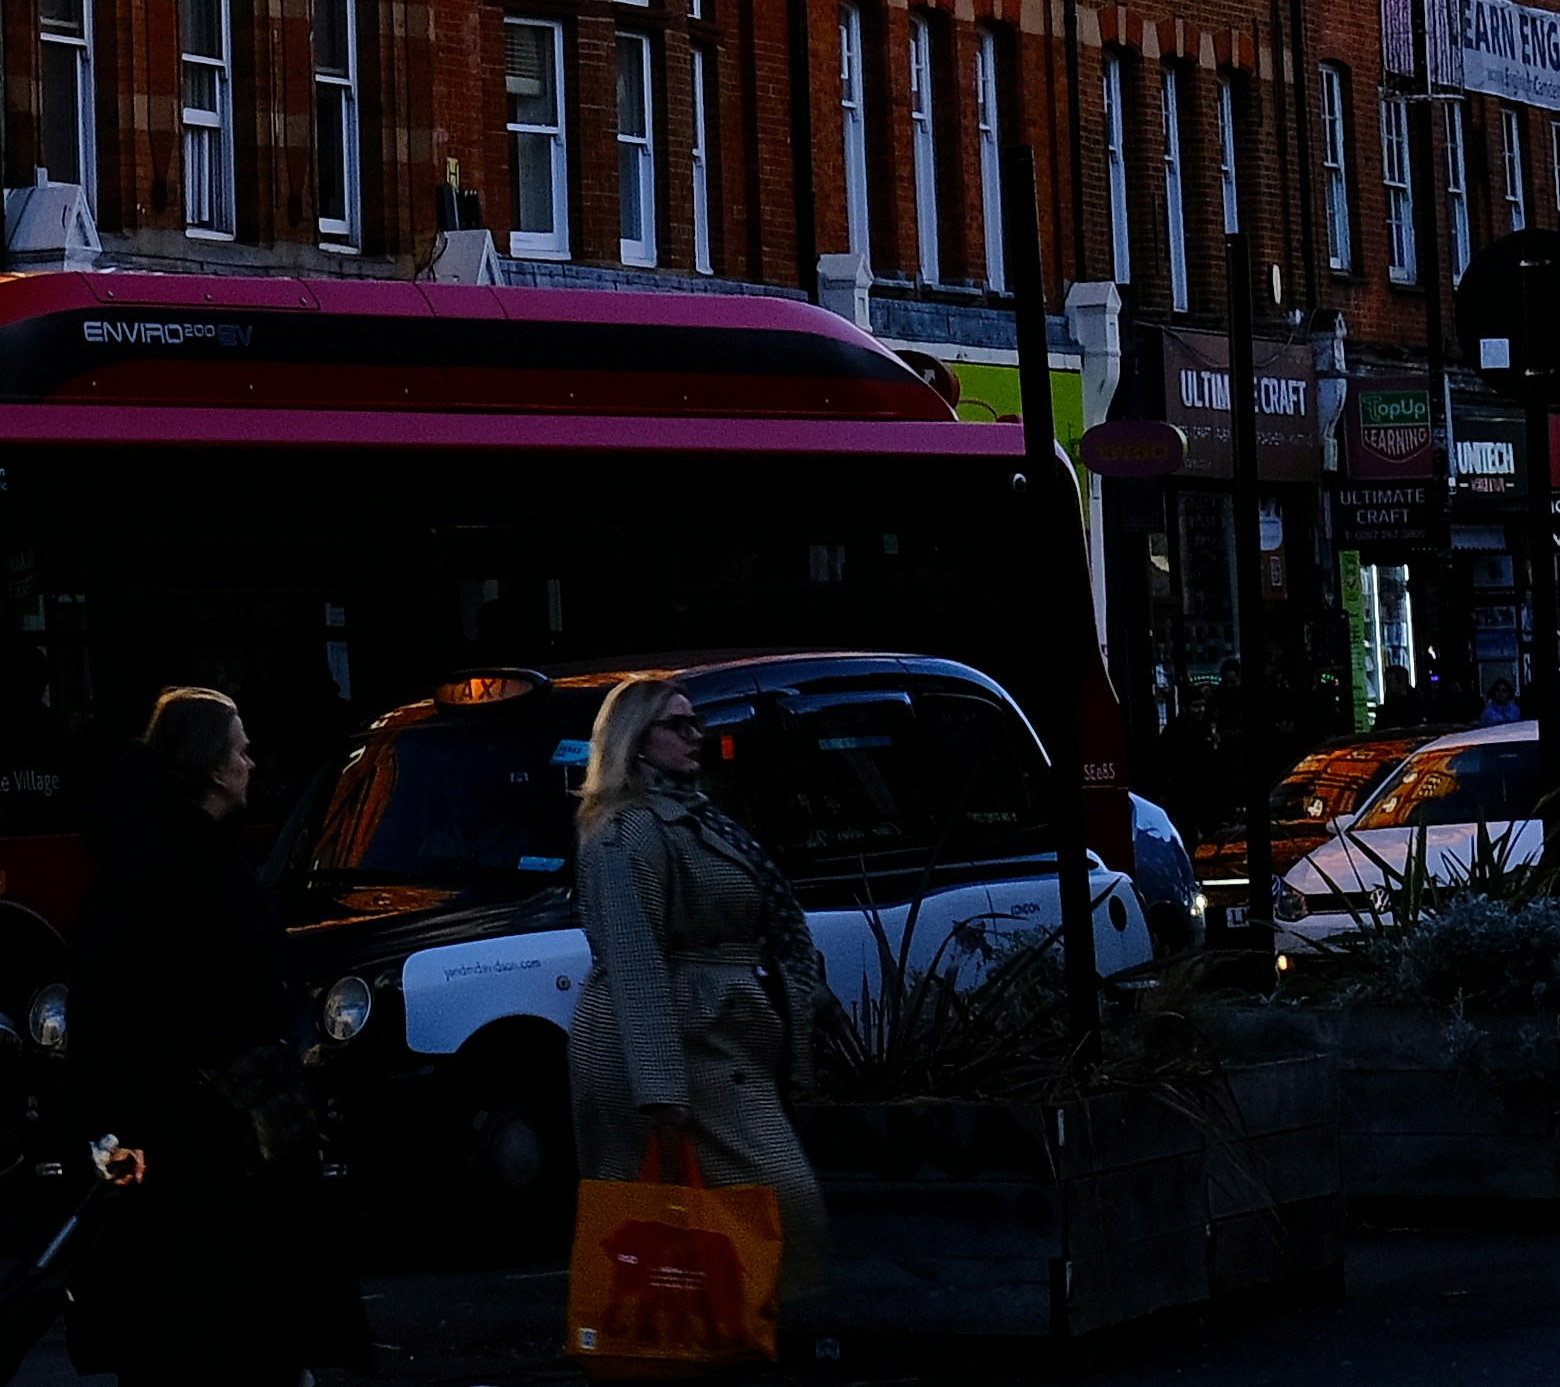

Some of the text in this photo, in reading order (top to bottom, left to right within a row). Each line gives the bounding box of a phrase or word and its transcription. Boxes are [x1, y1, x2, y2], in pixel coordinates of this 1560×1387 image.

[1260, 376, 1307, 417] CRAFT
[1362, 395, 1426, 422] TopUp
[1364, 427, 1427, 456] LEARNING
[1456, 441, 1515, 475] UNITECH
[1340, 488, 1426, 505] ULTIMATE
[1356, 508, 1409, 525] CRAFT
[13, 768, 61, 798] Village
